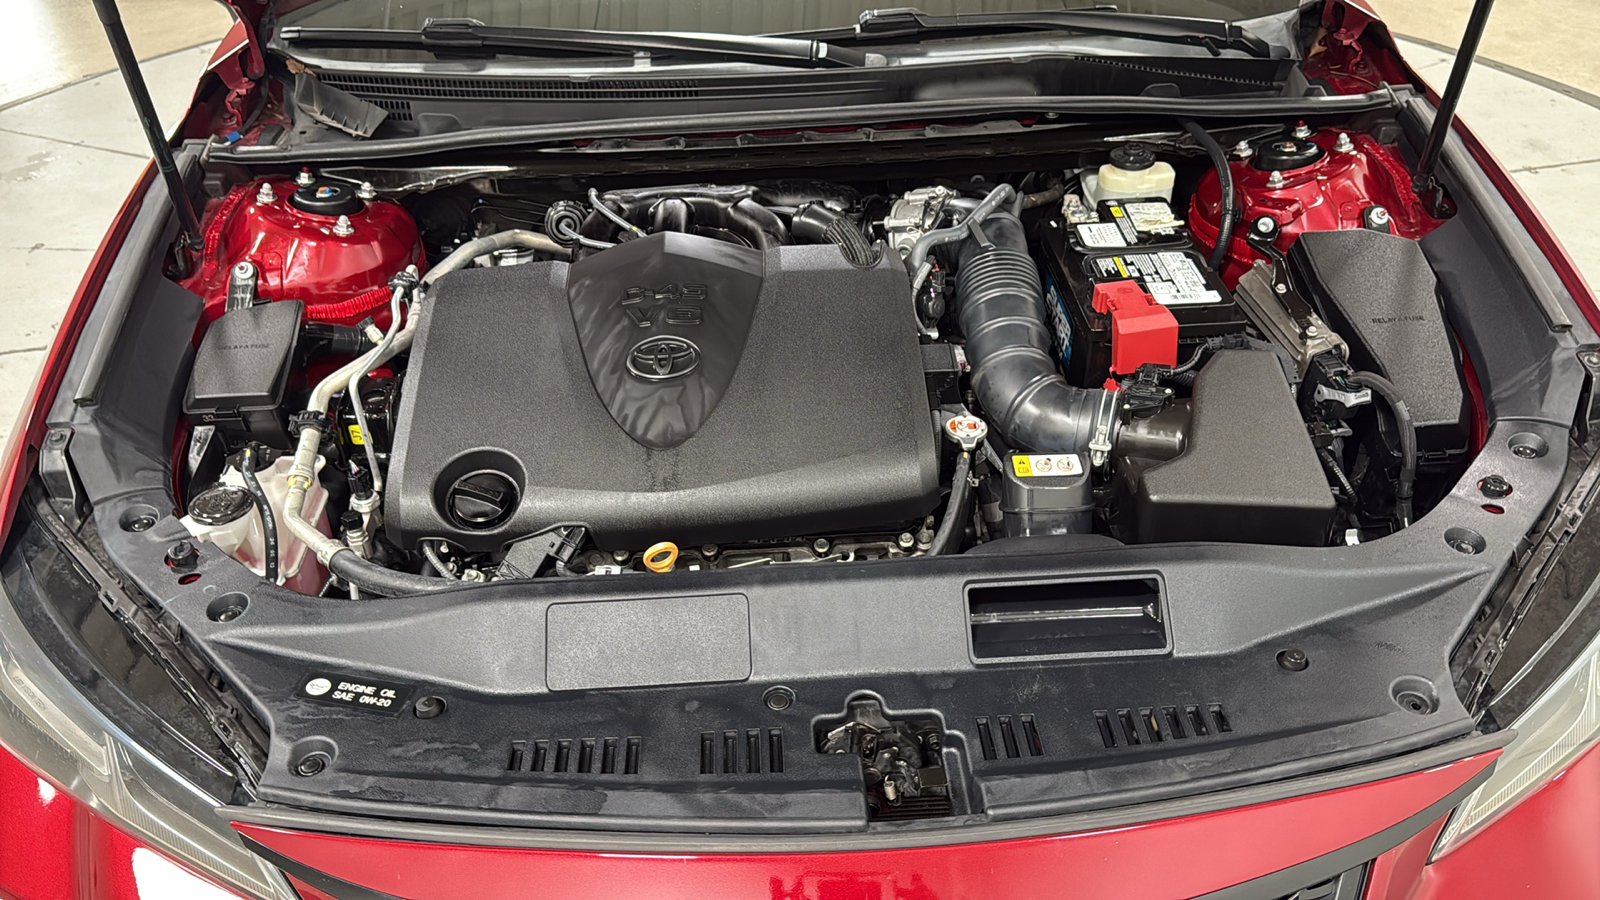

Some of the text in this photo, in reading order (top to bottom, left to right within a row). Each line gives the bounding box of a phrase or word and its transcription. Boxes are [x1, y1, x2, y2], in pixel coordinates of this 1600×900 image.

[626, 303, 703, 327] V6
[338, 682, 396, 698] ENGINE OIL
[332, 691, 392, 707] SAE 0W-20
